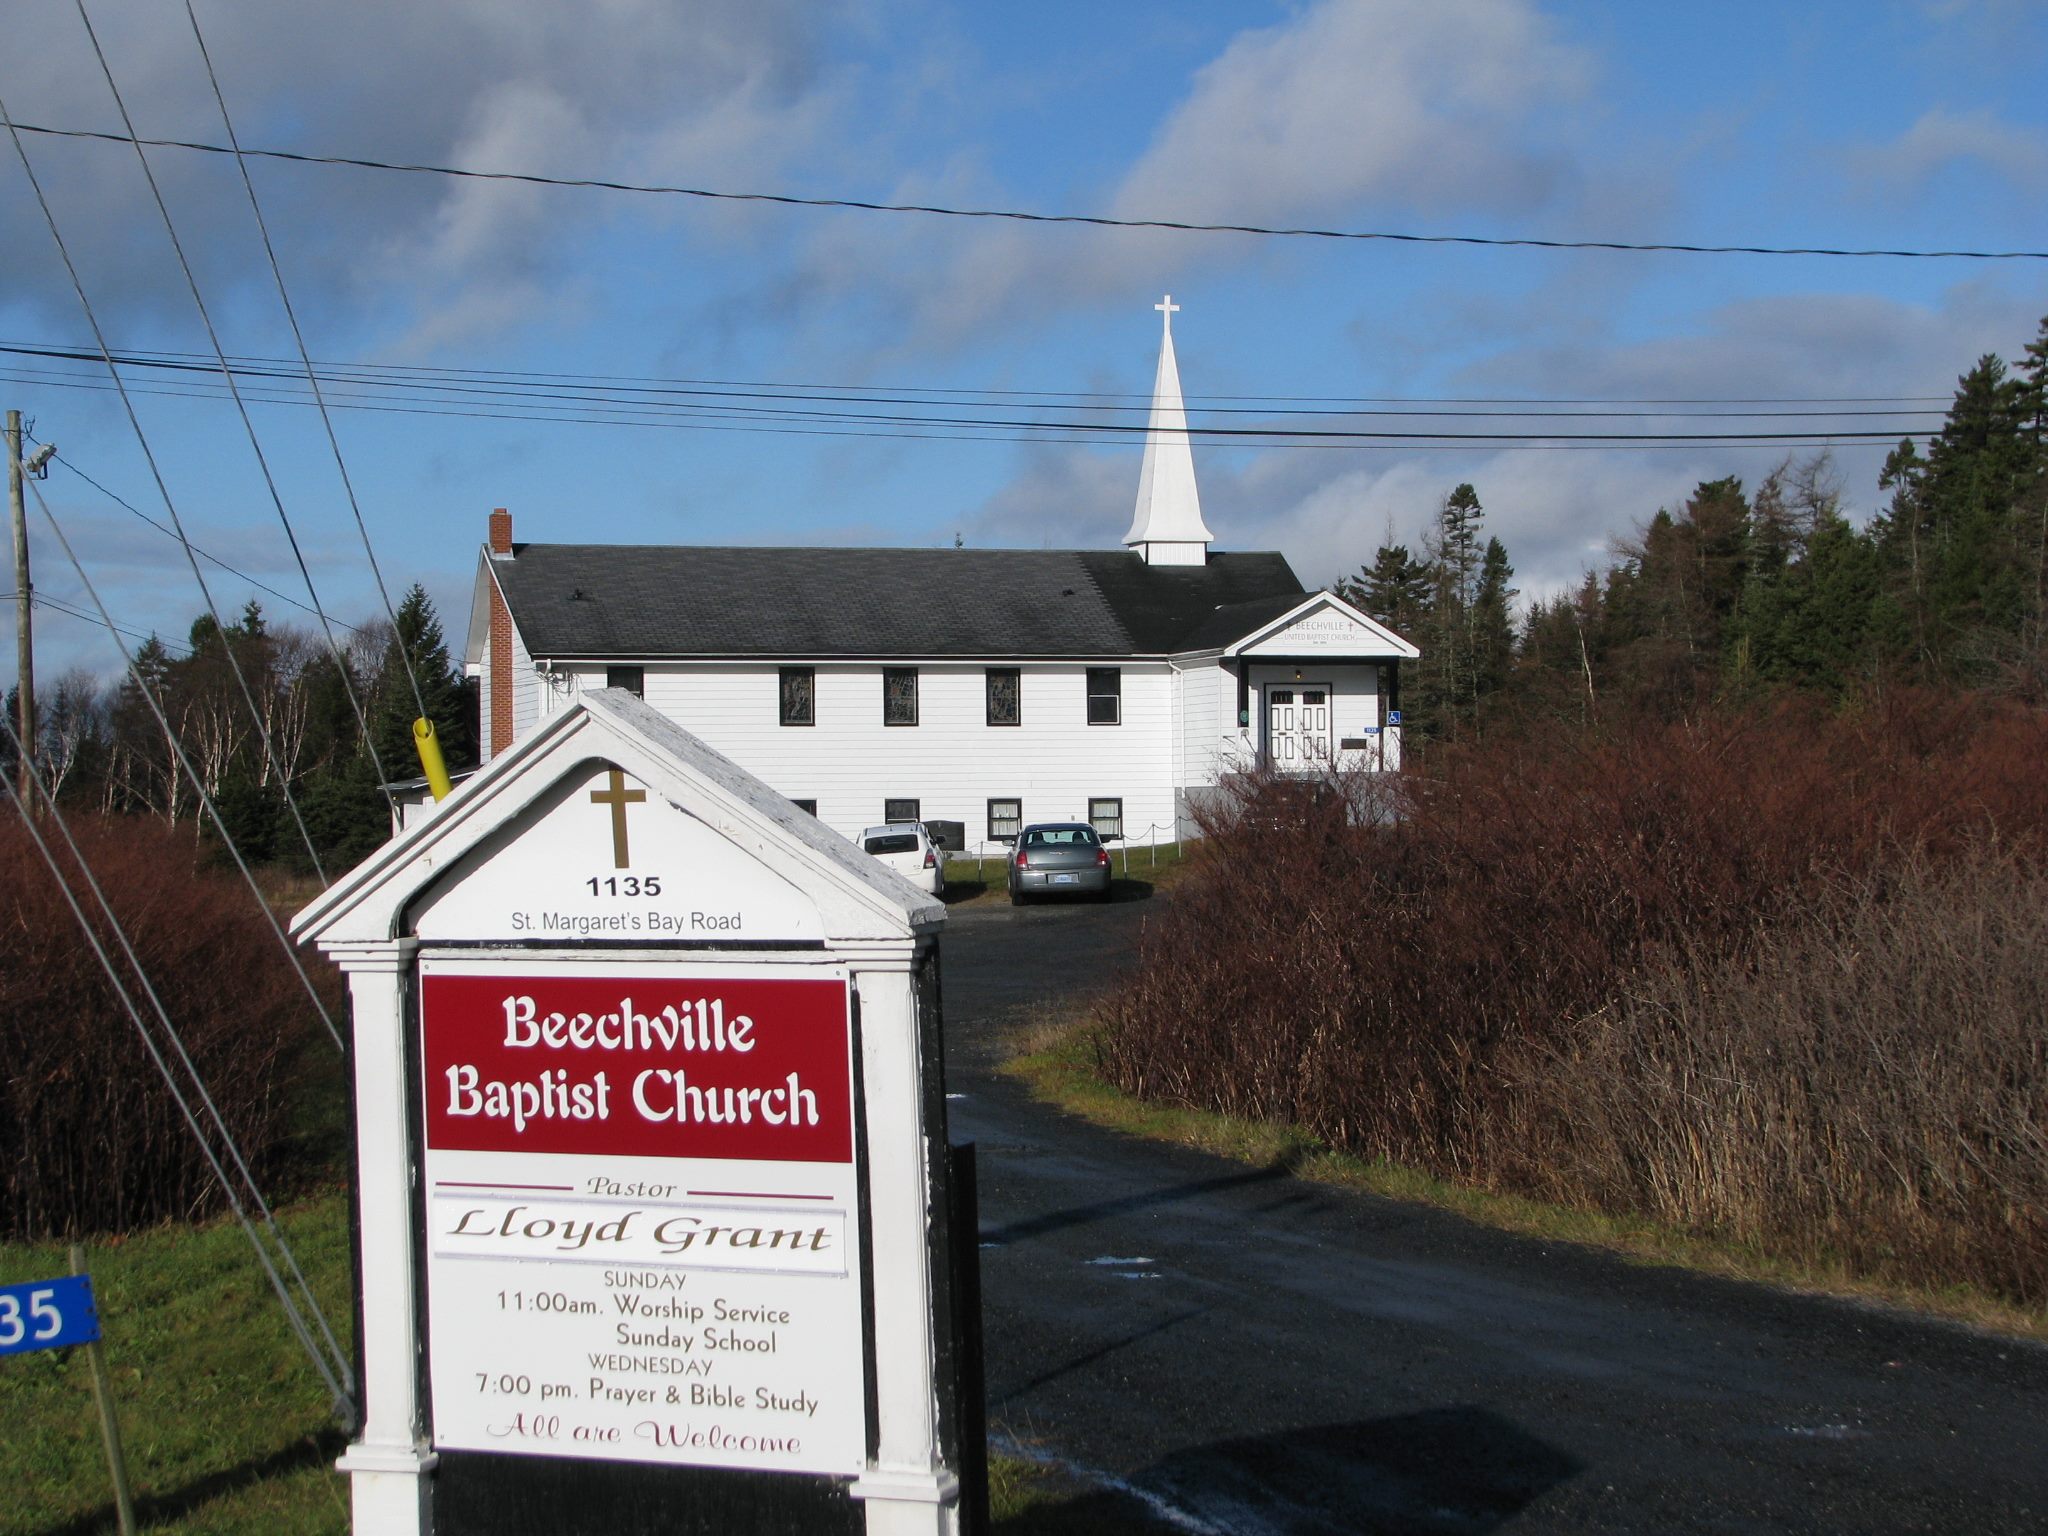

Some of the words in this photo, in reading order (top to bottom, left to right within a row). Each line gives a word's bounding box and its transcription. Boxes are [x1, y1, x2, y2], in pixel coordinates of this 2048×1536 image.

[1296, 621, 1344, 631] BEECHVILLE
[586, 876, 662, 898] 1135
[511, 911, 536, 931] St.
[543, 912, 642, 935] Margaret's
[648, 913, 686, 936] Bay
[691, 913, 742, 931] Road
[502, 995, 756, 1053] Beechville
[445, 1064, 611, 1134] Baptist
[632, 1068, 820, 1126] Church
[587, 1176, 678, 1200] Pastor
[445, 1206, 643, 1250] Lloyd
[653, 1216, 833, 1254] Grant
[604, 1270, 687, 1291] SUNDAY
[0, 1289, 62, 1345] 35
[613, 1294, 704, 1324] Worship
[713, 1298, 791, 1324] Service
[616, 1324, 694, 1352] Sunday
[704, 1328, 777, 1353] School
[588, 1353, 713, 1377] WEDNESDAY
[475, 1373, 531, 1395] 7:00
[541, 1383, 579, 1401] pm.
[590, 1378, 656, 1405] Prayer
[665, 1385, 681, 1404] &
[691, 1383, 746, 1408] Bible
[755, 1388, 819, 1417] Study
[486, 1412, 561, 1439] All
[572, 1424, 622, 1444] are
[633, 1420, 802, 1454] Welcome
